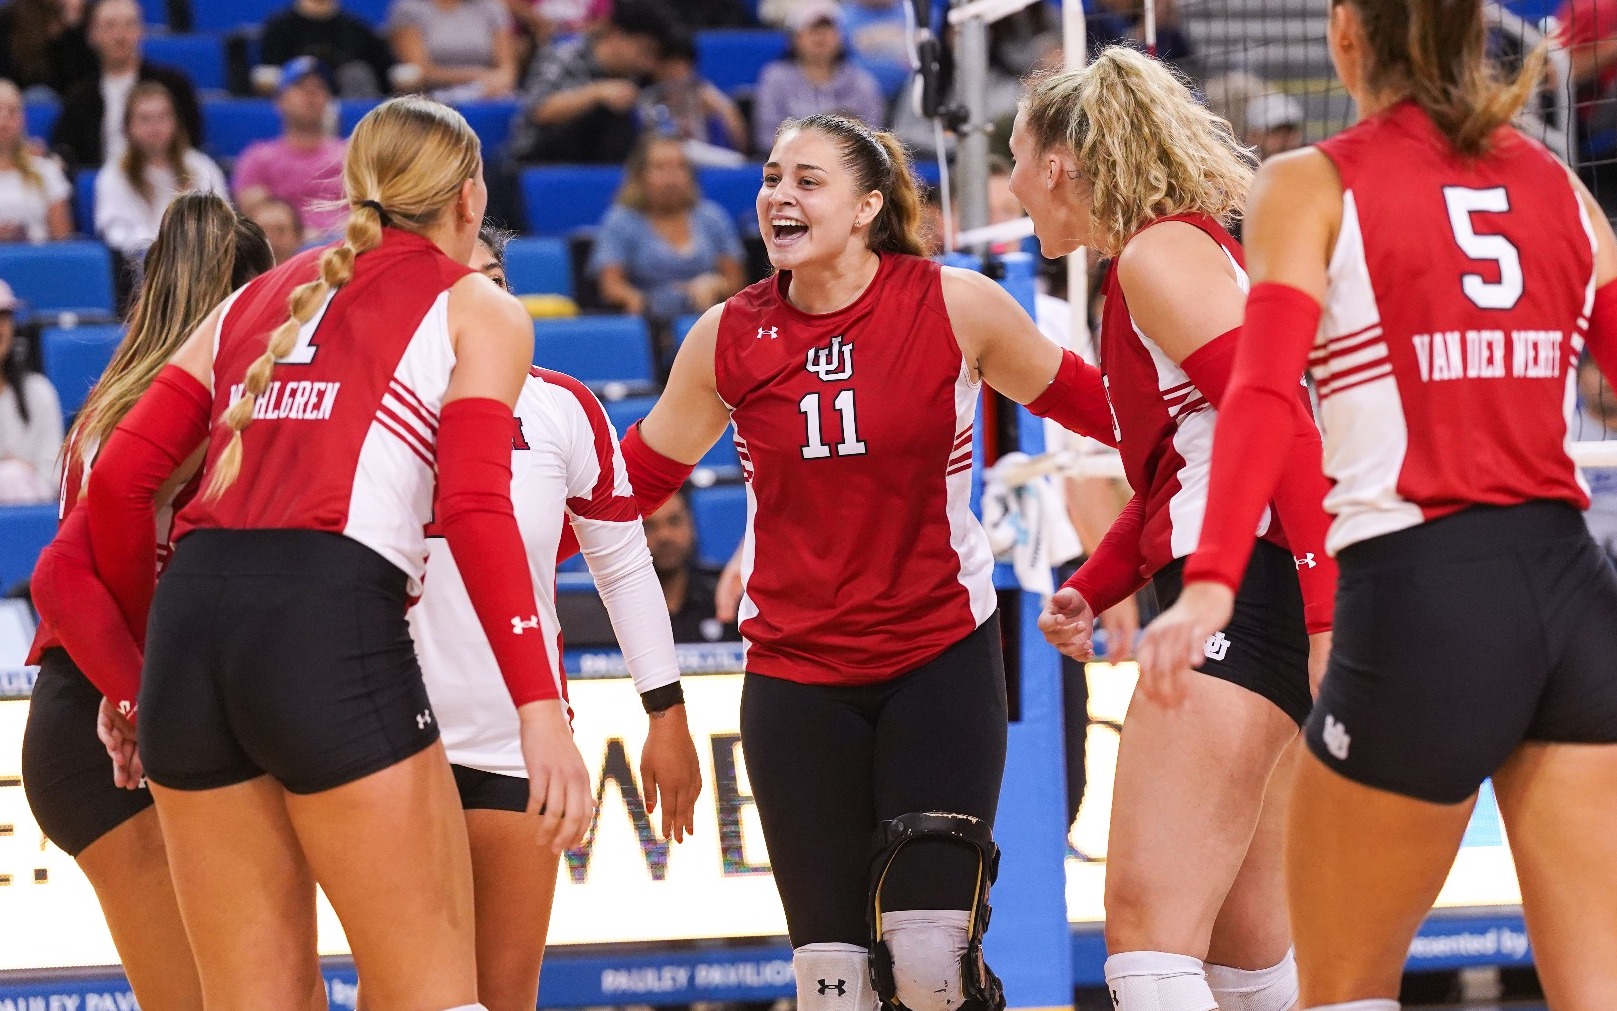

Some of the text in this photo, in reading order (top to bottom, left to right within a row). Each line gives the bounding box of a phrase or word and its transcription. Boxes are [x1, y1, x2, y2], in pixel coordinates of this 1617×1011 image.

[1442, 185, 1524, 310] 5
[1411, 333, 1464, 383] VAN
[1465, 329, 1506, 379] DER
[229, 380, 341, 420] WHLGREN
[798, 388, 867, 460] 11
[601, 959, 796, 994] PAULEY PAVILIO
